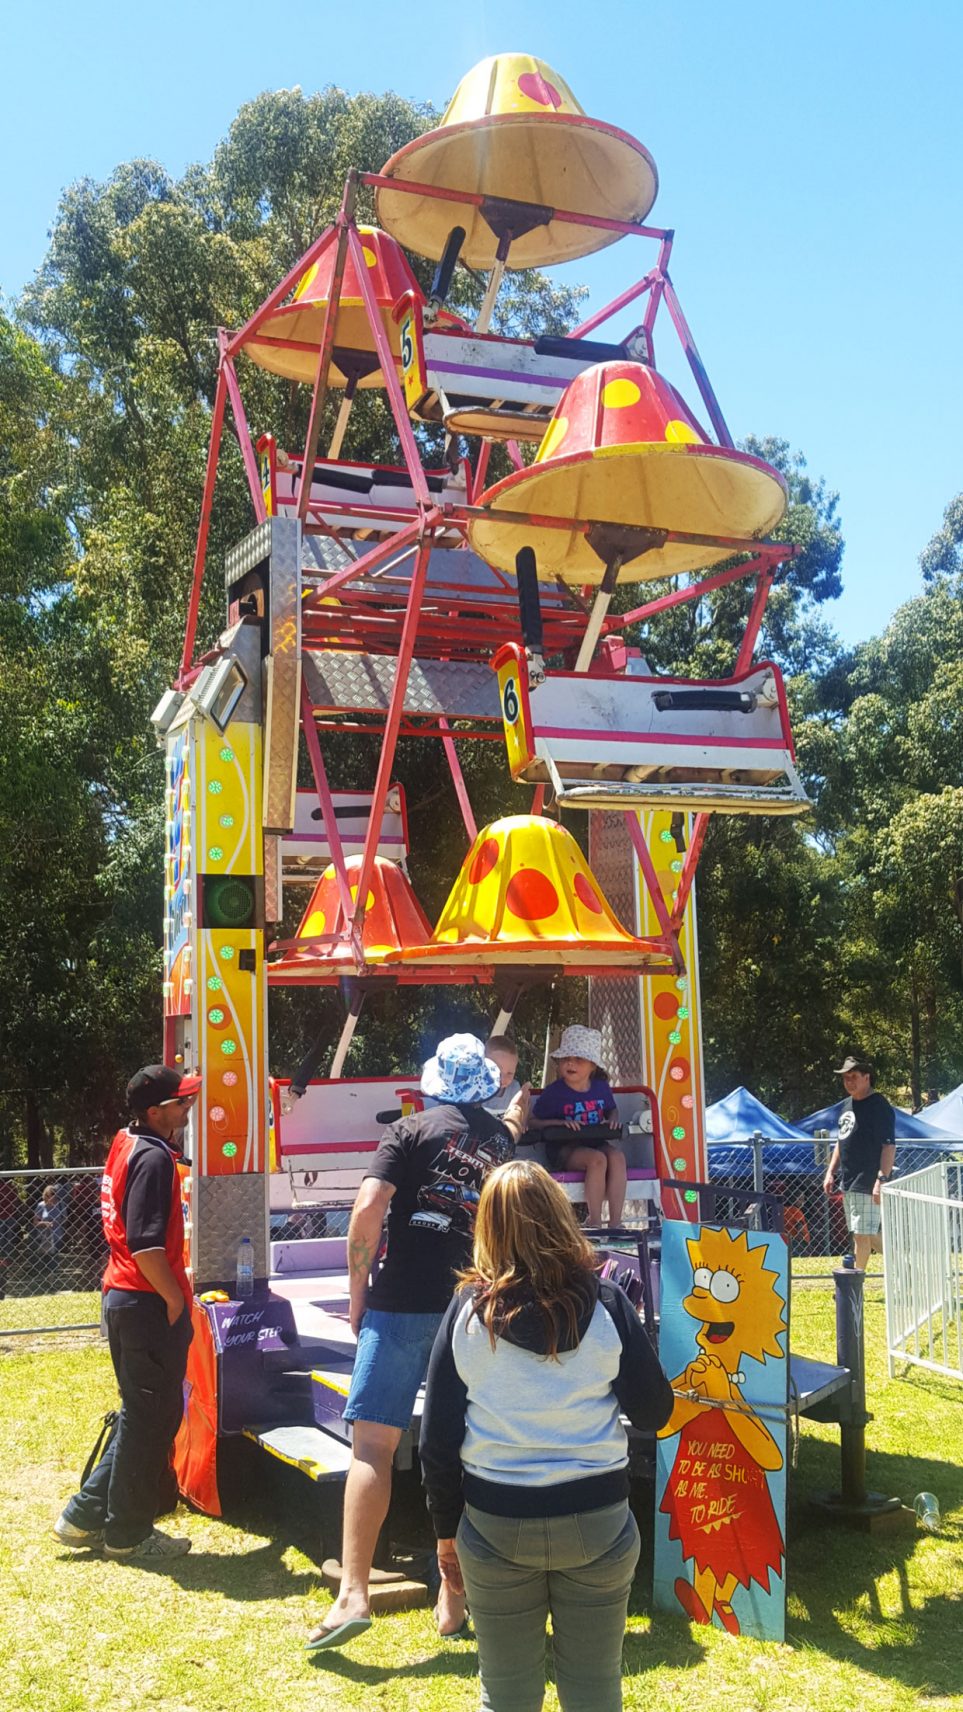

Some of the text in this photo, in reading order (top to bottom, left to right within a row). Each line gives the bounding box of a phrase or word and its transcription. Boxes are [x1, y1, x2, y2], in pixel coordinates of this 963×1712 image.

[402, 318, 413, 371] 5
[262, 455, 271, 492] 4
[502, 677, 519, 724] 6
[221, 1310, 264, 1329] WATCH
[224, 1326, 282, 1347] YOUR STEP
[687, 1440, 736, 1460] YOU NEED
[674, 1479, 708, 1499] AS ME.
[678, 1460, 764, 1489] TO BE AS SHT
[690, 1493, 738, 1524] TO RIDE
